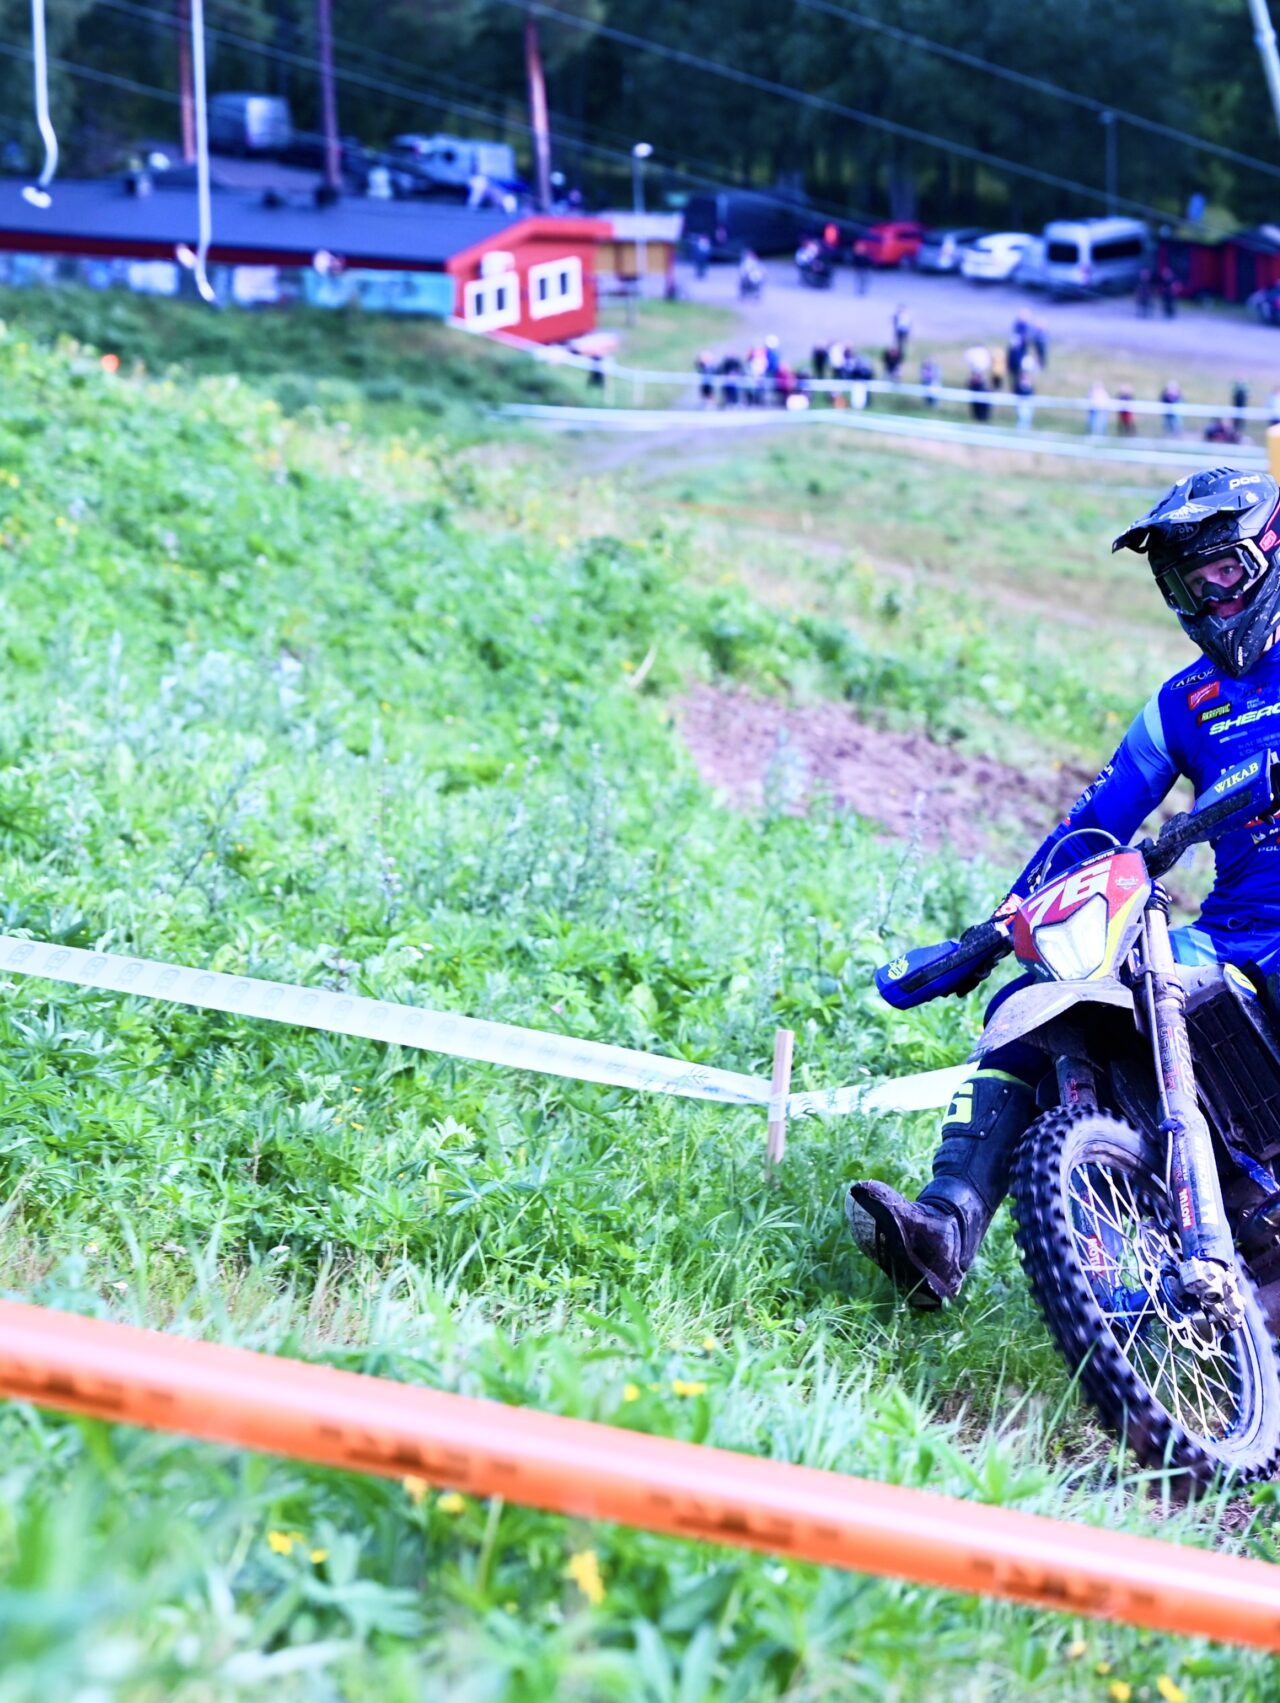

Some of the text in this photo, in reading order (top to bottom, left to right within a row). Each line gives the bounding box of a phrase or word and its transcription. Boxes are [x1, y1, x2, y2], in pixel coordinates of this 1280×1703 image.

[1213, 761, 1260, 794] WIKAB
[1027, 859, 1113, 935] 76
[1178, 1188, 1192, 1228] MOTUL
